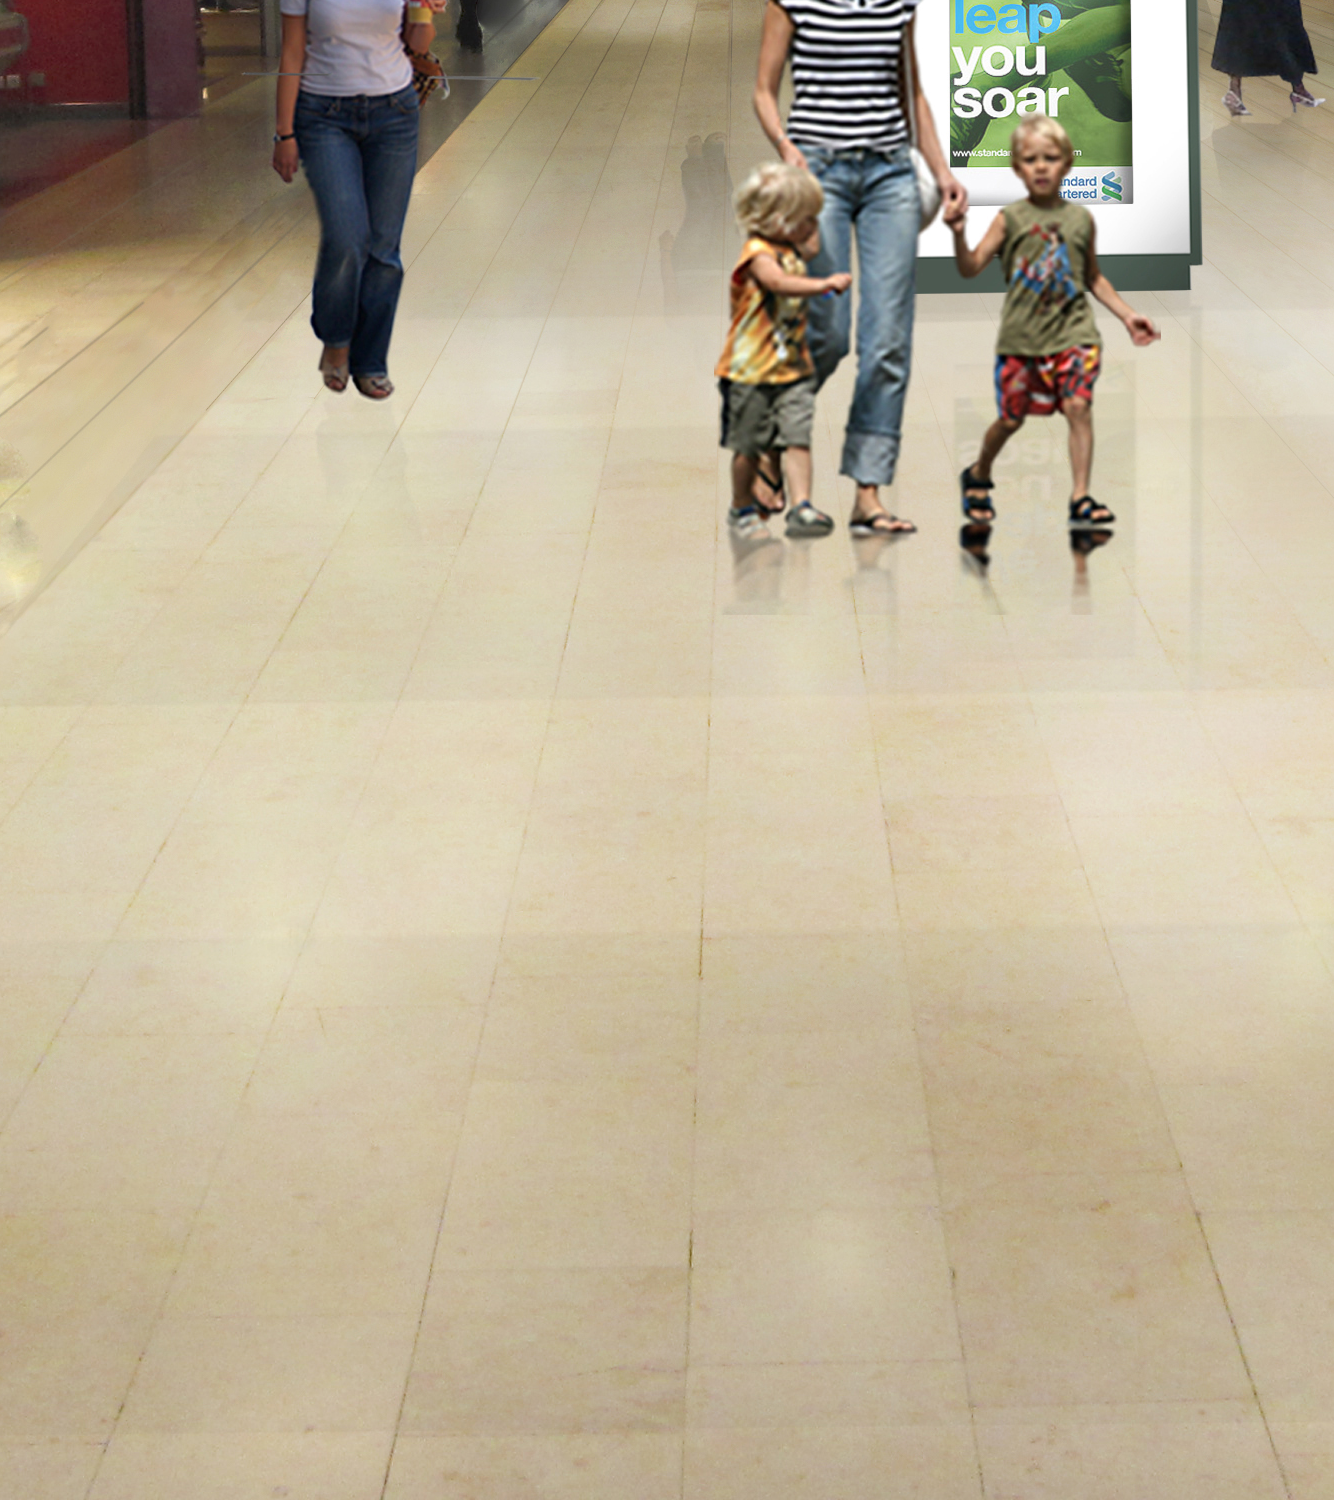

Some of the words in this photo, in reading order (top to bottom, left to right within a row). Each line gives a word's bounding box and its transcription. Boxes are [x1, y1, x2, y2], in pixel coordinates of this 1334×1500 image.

[952, 45, 1046, 86] you
[953, 86, 1070, 118] soar
[1058, 176, 1097, 187] andard
[1057, 188, 1097, 199] artered
